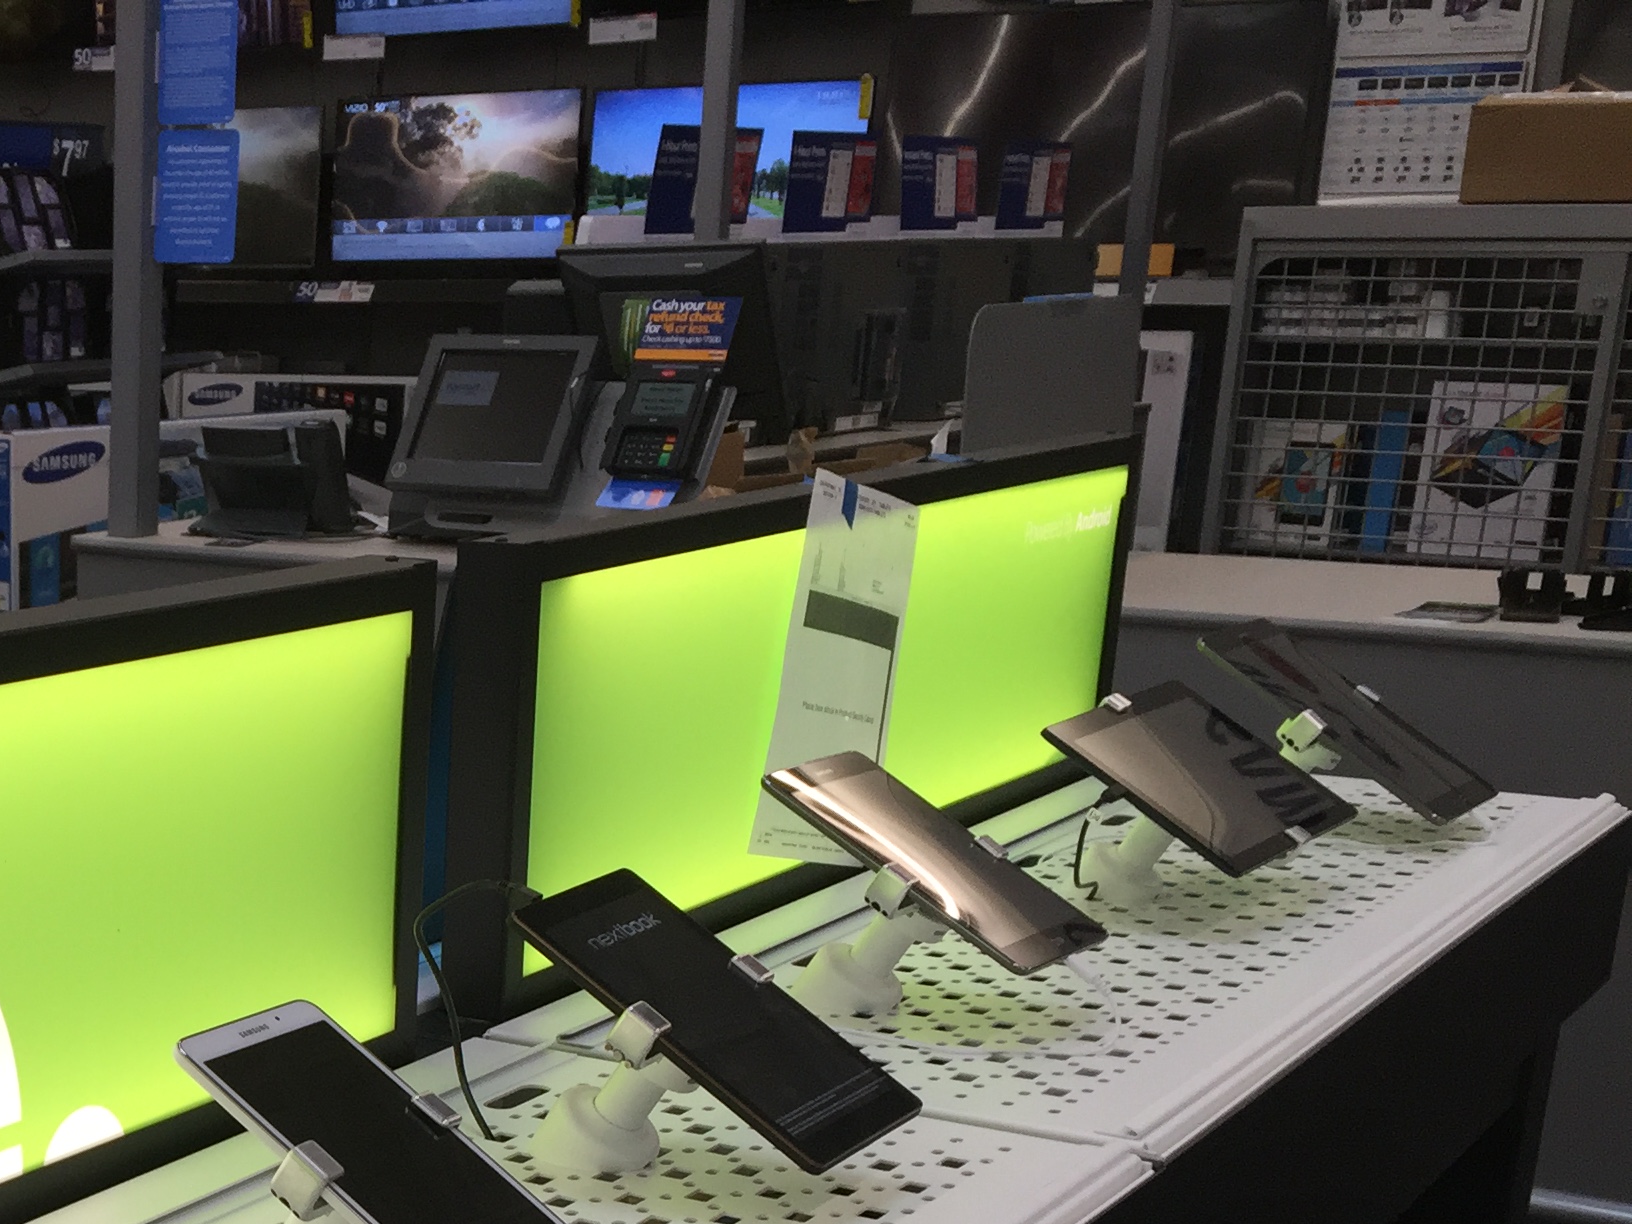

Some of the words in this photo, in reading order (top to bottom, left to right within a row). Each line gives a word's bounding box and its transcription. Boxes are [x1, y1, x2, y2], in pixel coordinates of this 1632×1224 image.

[74, 47, 92, 65] 50
[296, 281, 319, 297] 50
[652, 299, 679, 311] Cash
[679, 301, 706, 313] your
[706, 301, 726, 311] tax
[649, 311, 688, 323] refund
[644, 322, 662, 333] for
[675, 324, 687, 334] or
[194, 388, 237, 400] SAMSUNG
[31, 451, 98, 473] SAMSUNG
[1074, 503, 1112, 533] Android
[588, 911, 662, 950] nextbook
[238, 1023, 270, 1038] SAMSUNG
